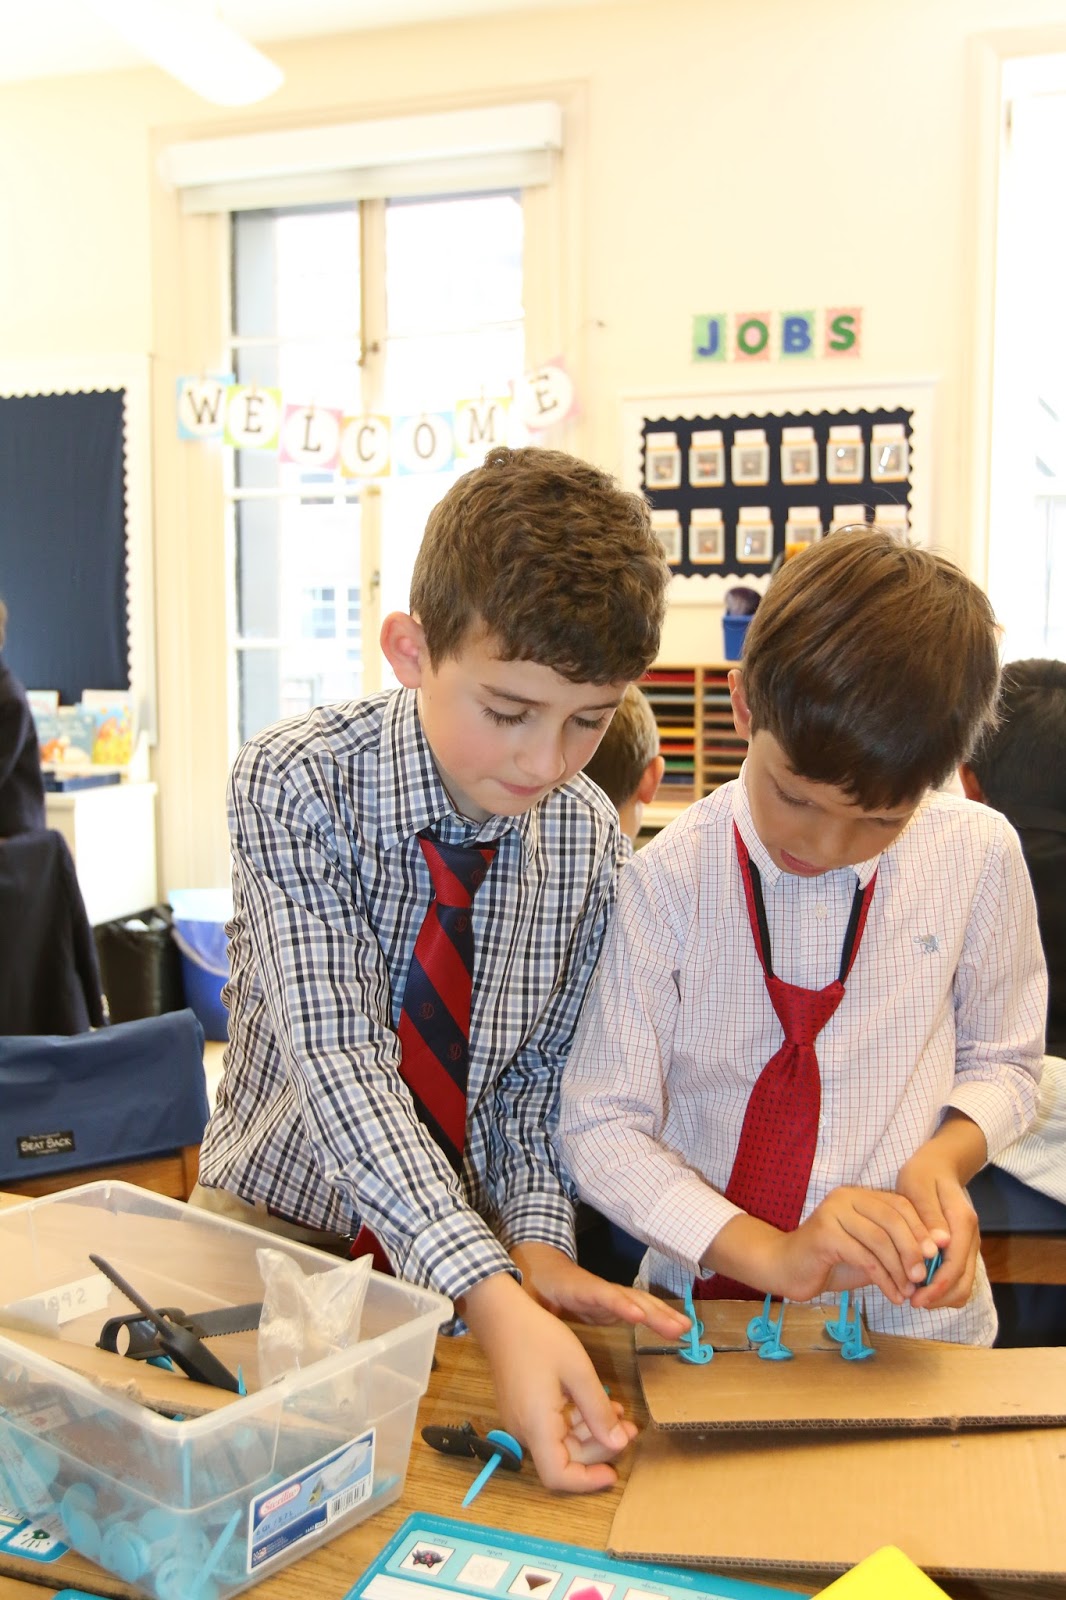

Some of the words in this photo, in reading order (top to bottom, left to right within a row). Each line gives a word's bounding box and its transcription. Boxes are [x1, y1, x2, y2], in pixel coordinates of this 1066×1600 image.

[697, 314, 857, 357] JOBS
[186, 373, 559, 463] WELCOME
[20, 1140, 45, 1152] SEAT
[45, 1137, 73, 1149] SACK
